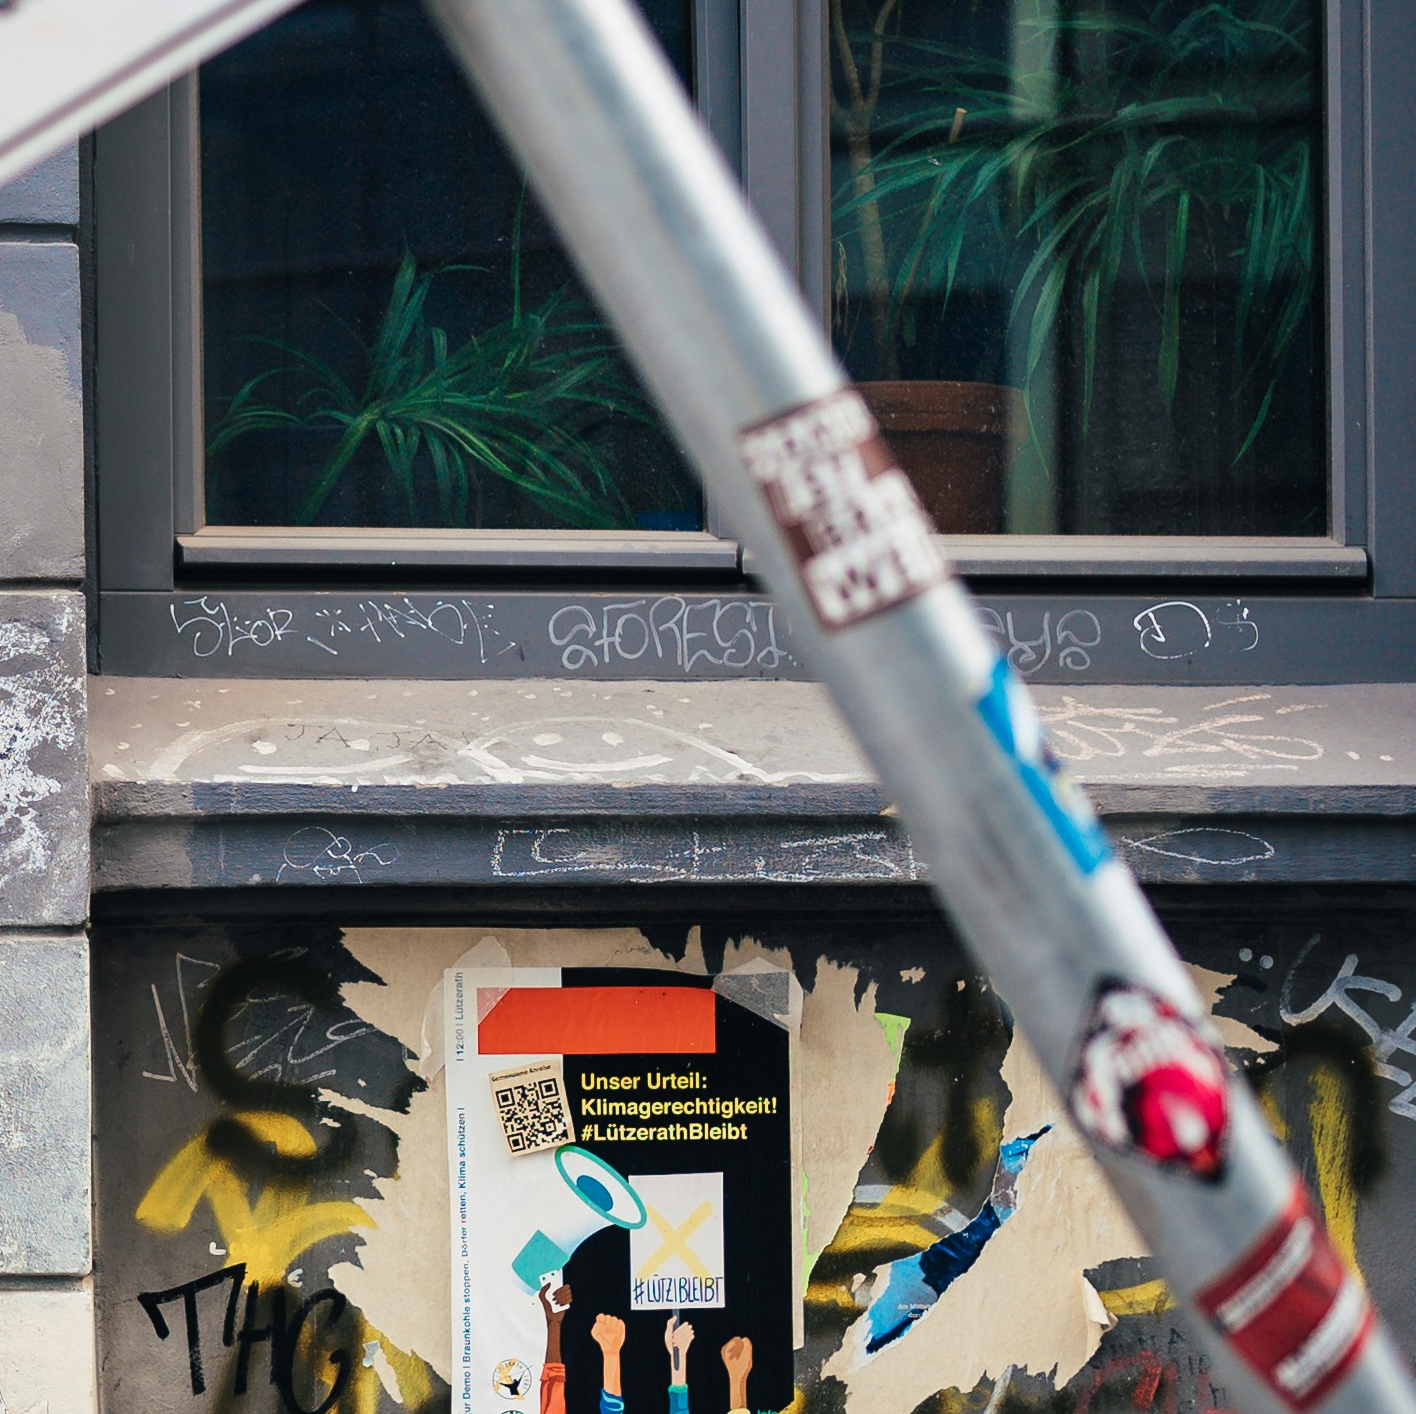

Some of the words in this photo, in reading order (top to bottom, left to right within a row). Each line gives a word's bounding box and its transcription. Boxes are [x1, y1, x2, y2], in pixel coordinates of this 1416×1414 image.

[455, 972, 465, 1020] Lützerath
[456, 1027, 465, 1056] 12:00
[581, 1073, 640, 1090] Unser
[647, 1072, 707, 1089] Urteil:
[581, 1097, 778, 1119] Klimagerechtigkeit!
[457, 1114, 467, 1158] schützen
[581, 1123, 748, 1142] #LützerathBleibt
[458, 1160, 467, 1189] Klima
[460, 1225, 469, 1257] Dörfer
[461, 1307, 472, 1363] Braunkohle
[461, 1371, 471, 1400] Demo
